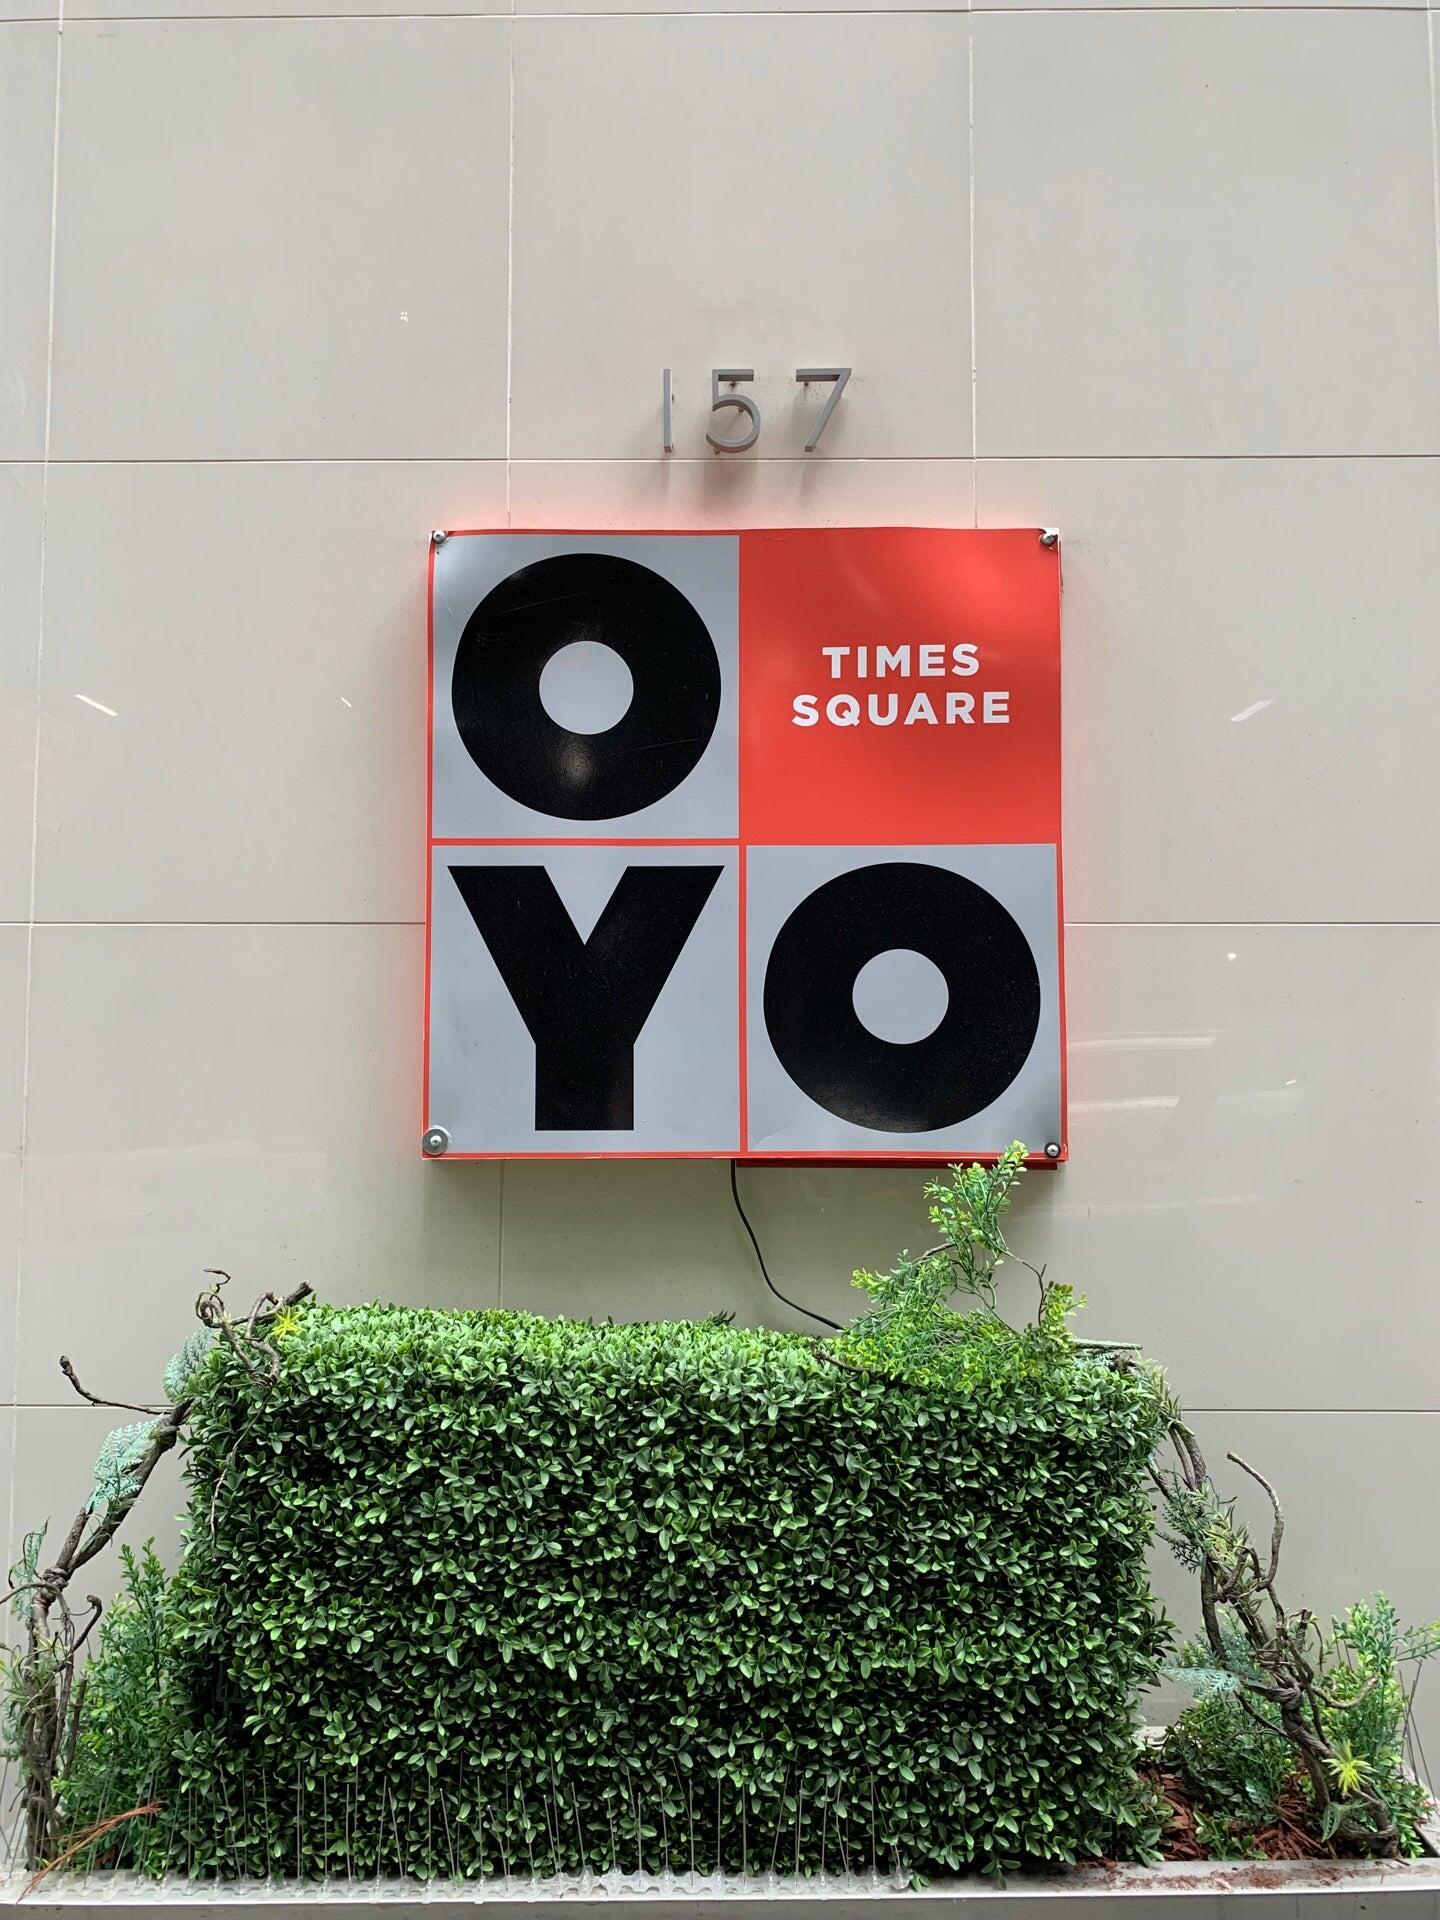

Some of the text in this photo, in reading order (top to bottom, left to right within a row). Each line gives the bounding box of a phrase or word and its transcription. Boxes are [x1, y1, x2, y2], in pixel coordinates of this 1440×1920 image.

[662, 367, 852, 453] 157
[821, 643, 980, 679] TIMES
[791, 691, 1010, 727] SQUARE
